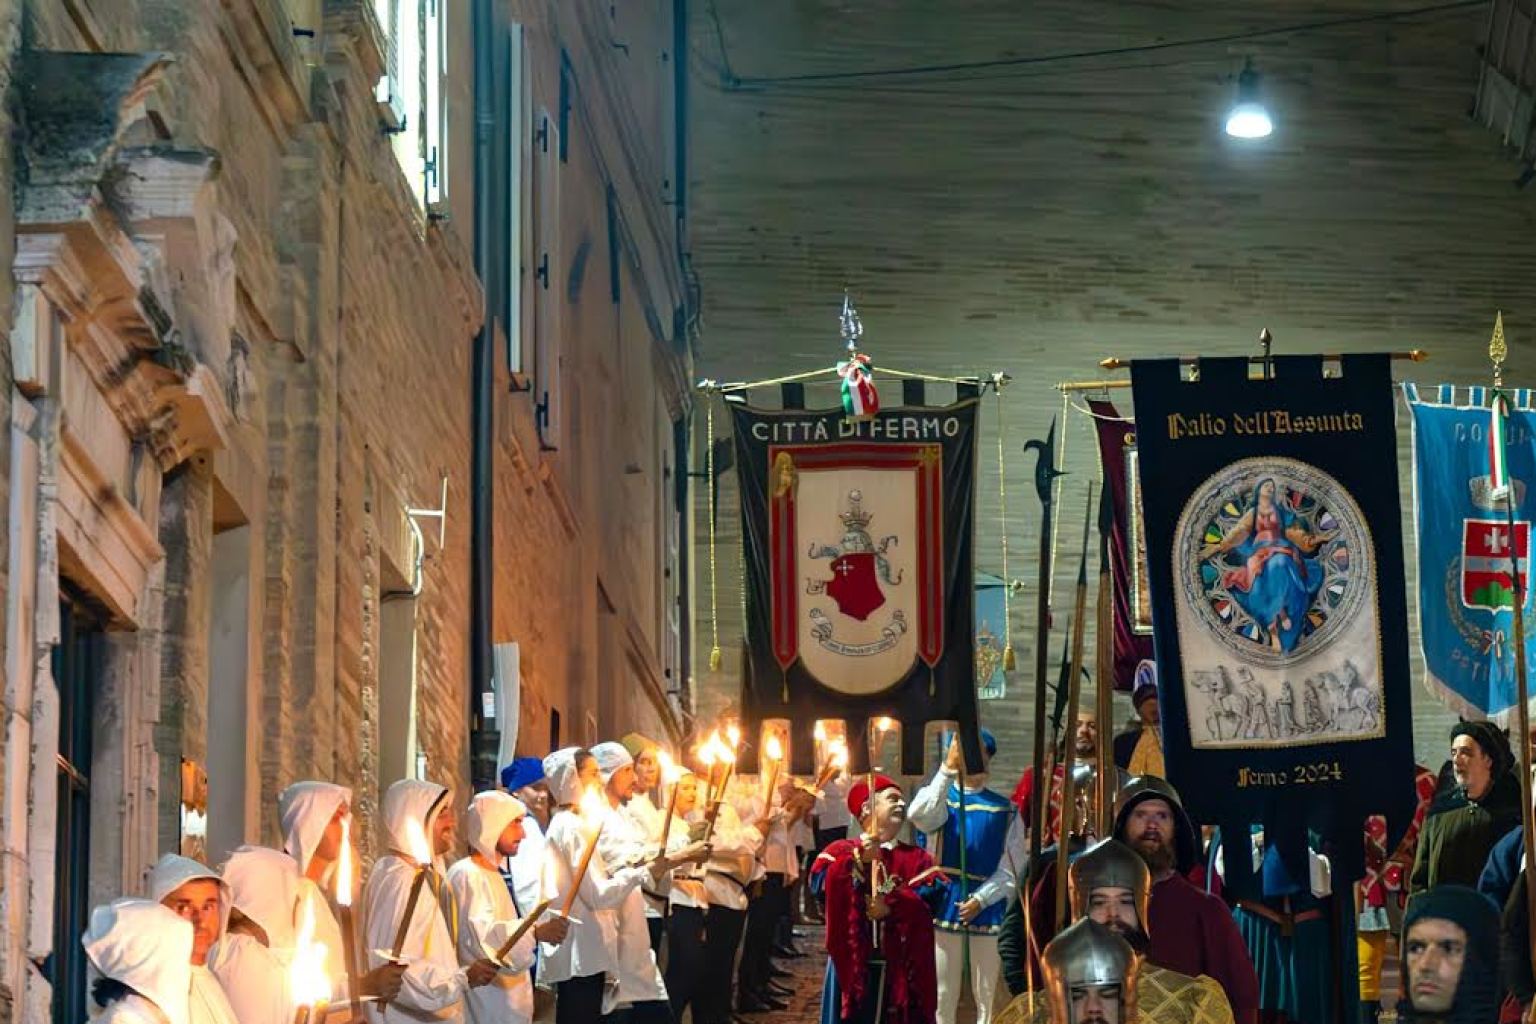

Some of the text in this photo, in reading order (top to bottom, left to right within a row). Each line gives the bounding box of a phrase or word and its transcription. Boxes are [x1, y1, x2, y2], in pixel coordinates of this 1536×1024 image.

[752, 418, 828, 441] CITTÀ
[869, 417, 960, 439] FERMO
[1167, 411, 1227, 439] Palio
[1294, 762, 1342, 784] 2024
